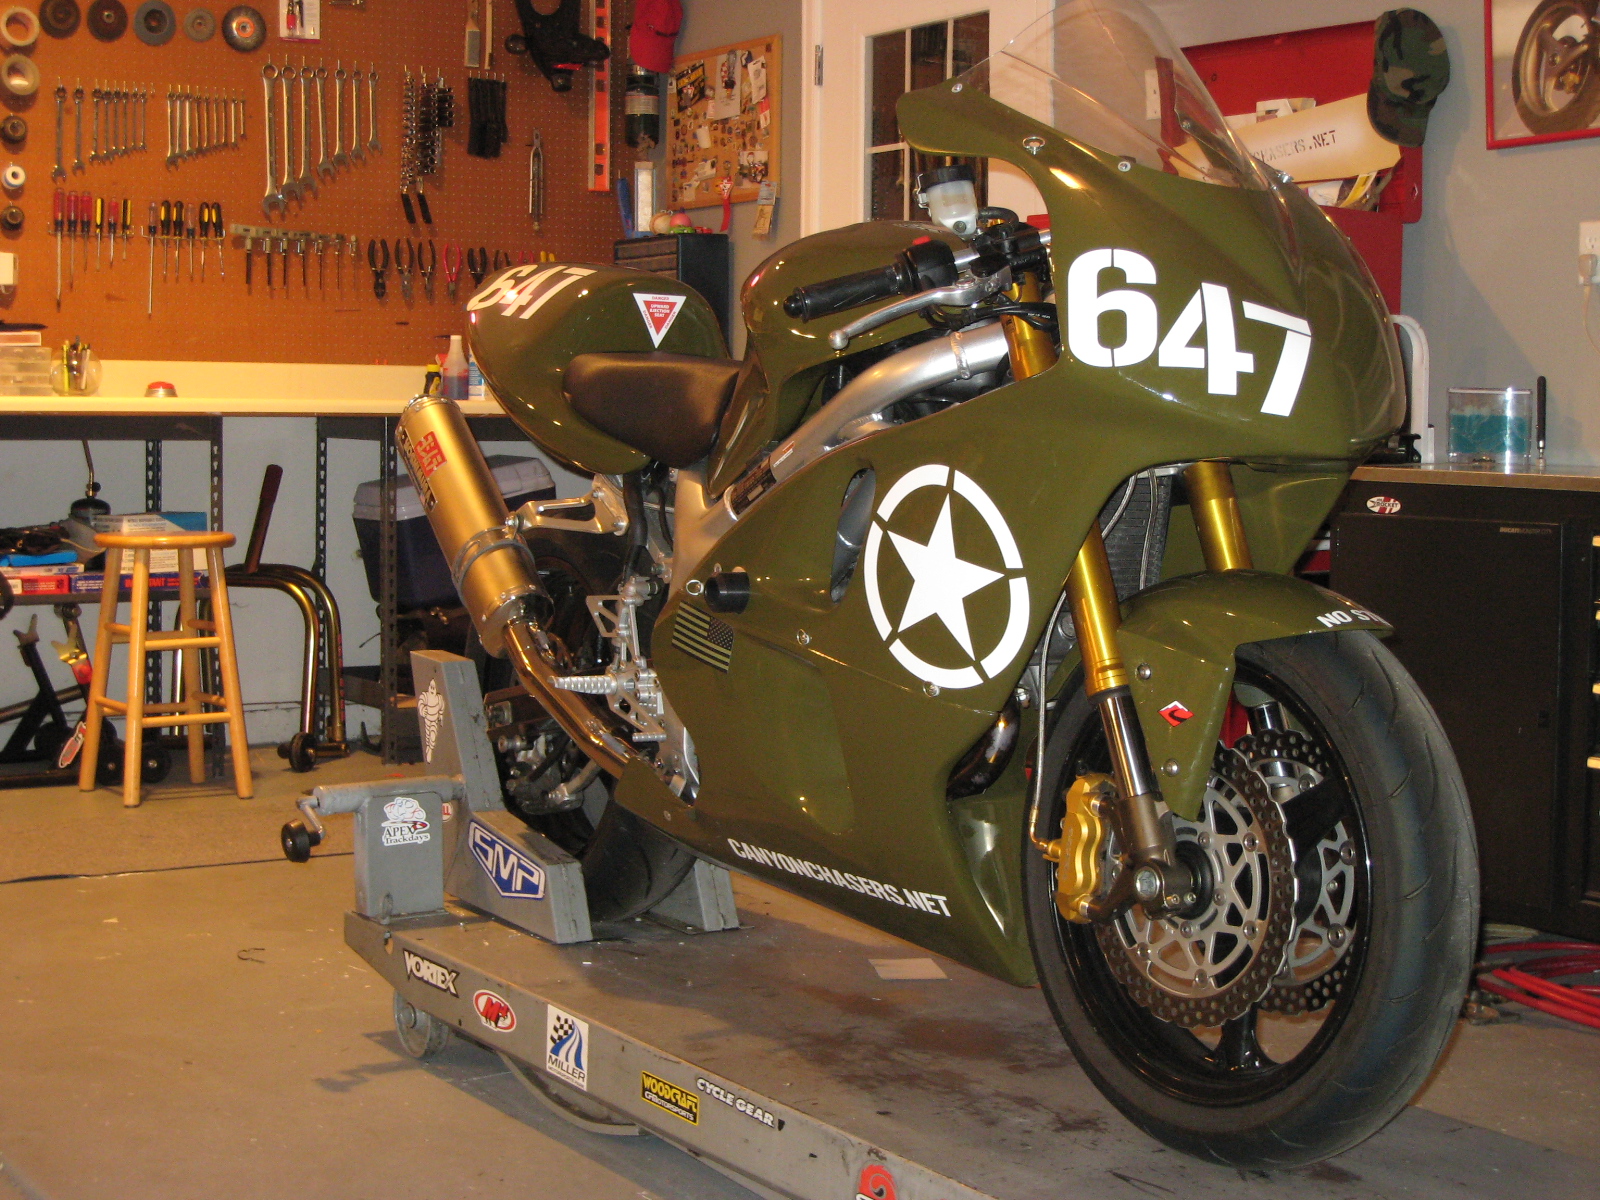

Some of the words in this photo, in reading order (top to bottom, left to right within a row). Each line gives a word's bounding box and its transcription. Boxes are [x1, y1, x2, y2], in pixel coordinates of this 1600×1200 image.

[466, 264, 598, 320] 647
[1068, 248, 1312, 417] 647
[1316, 610, 1353, 628] NO
[385, 825, 416, 838] APEX
[385, 834, 429, 845] Trackdays
[474, 827, 540, 892] SMP
[727, 838, 951, 917] CANYONCHASERS.NET
[403, 949, 459, 997] VORTEX
[548, 1055, 586, 1082] MILLER
[642, 1073, 697, 1112] WOODCRAFT
[696, 1077, 735, 1107] CYCLE
[735, 1097, 775, 1129] GEAR
